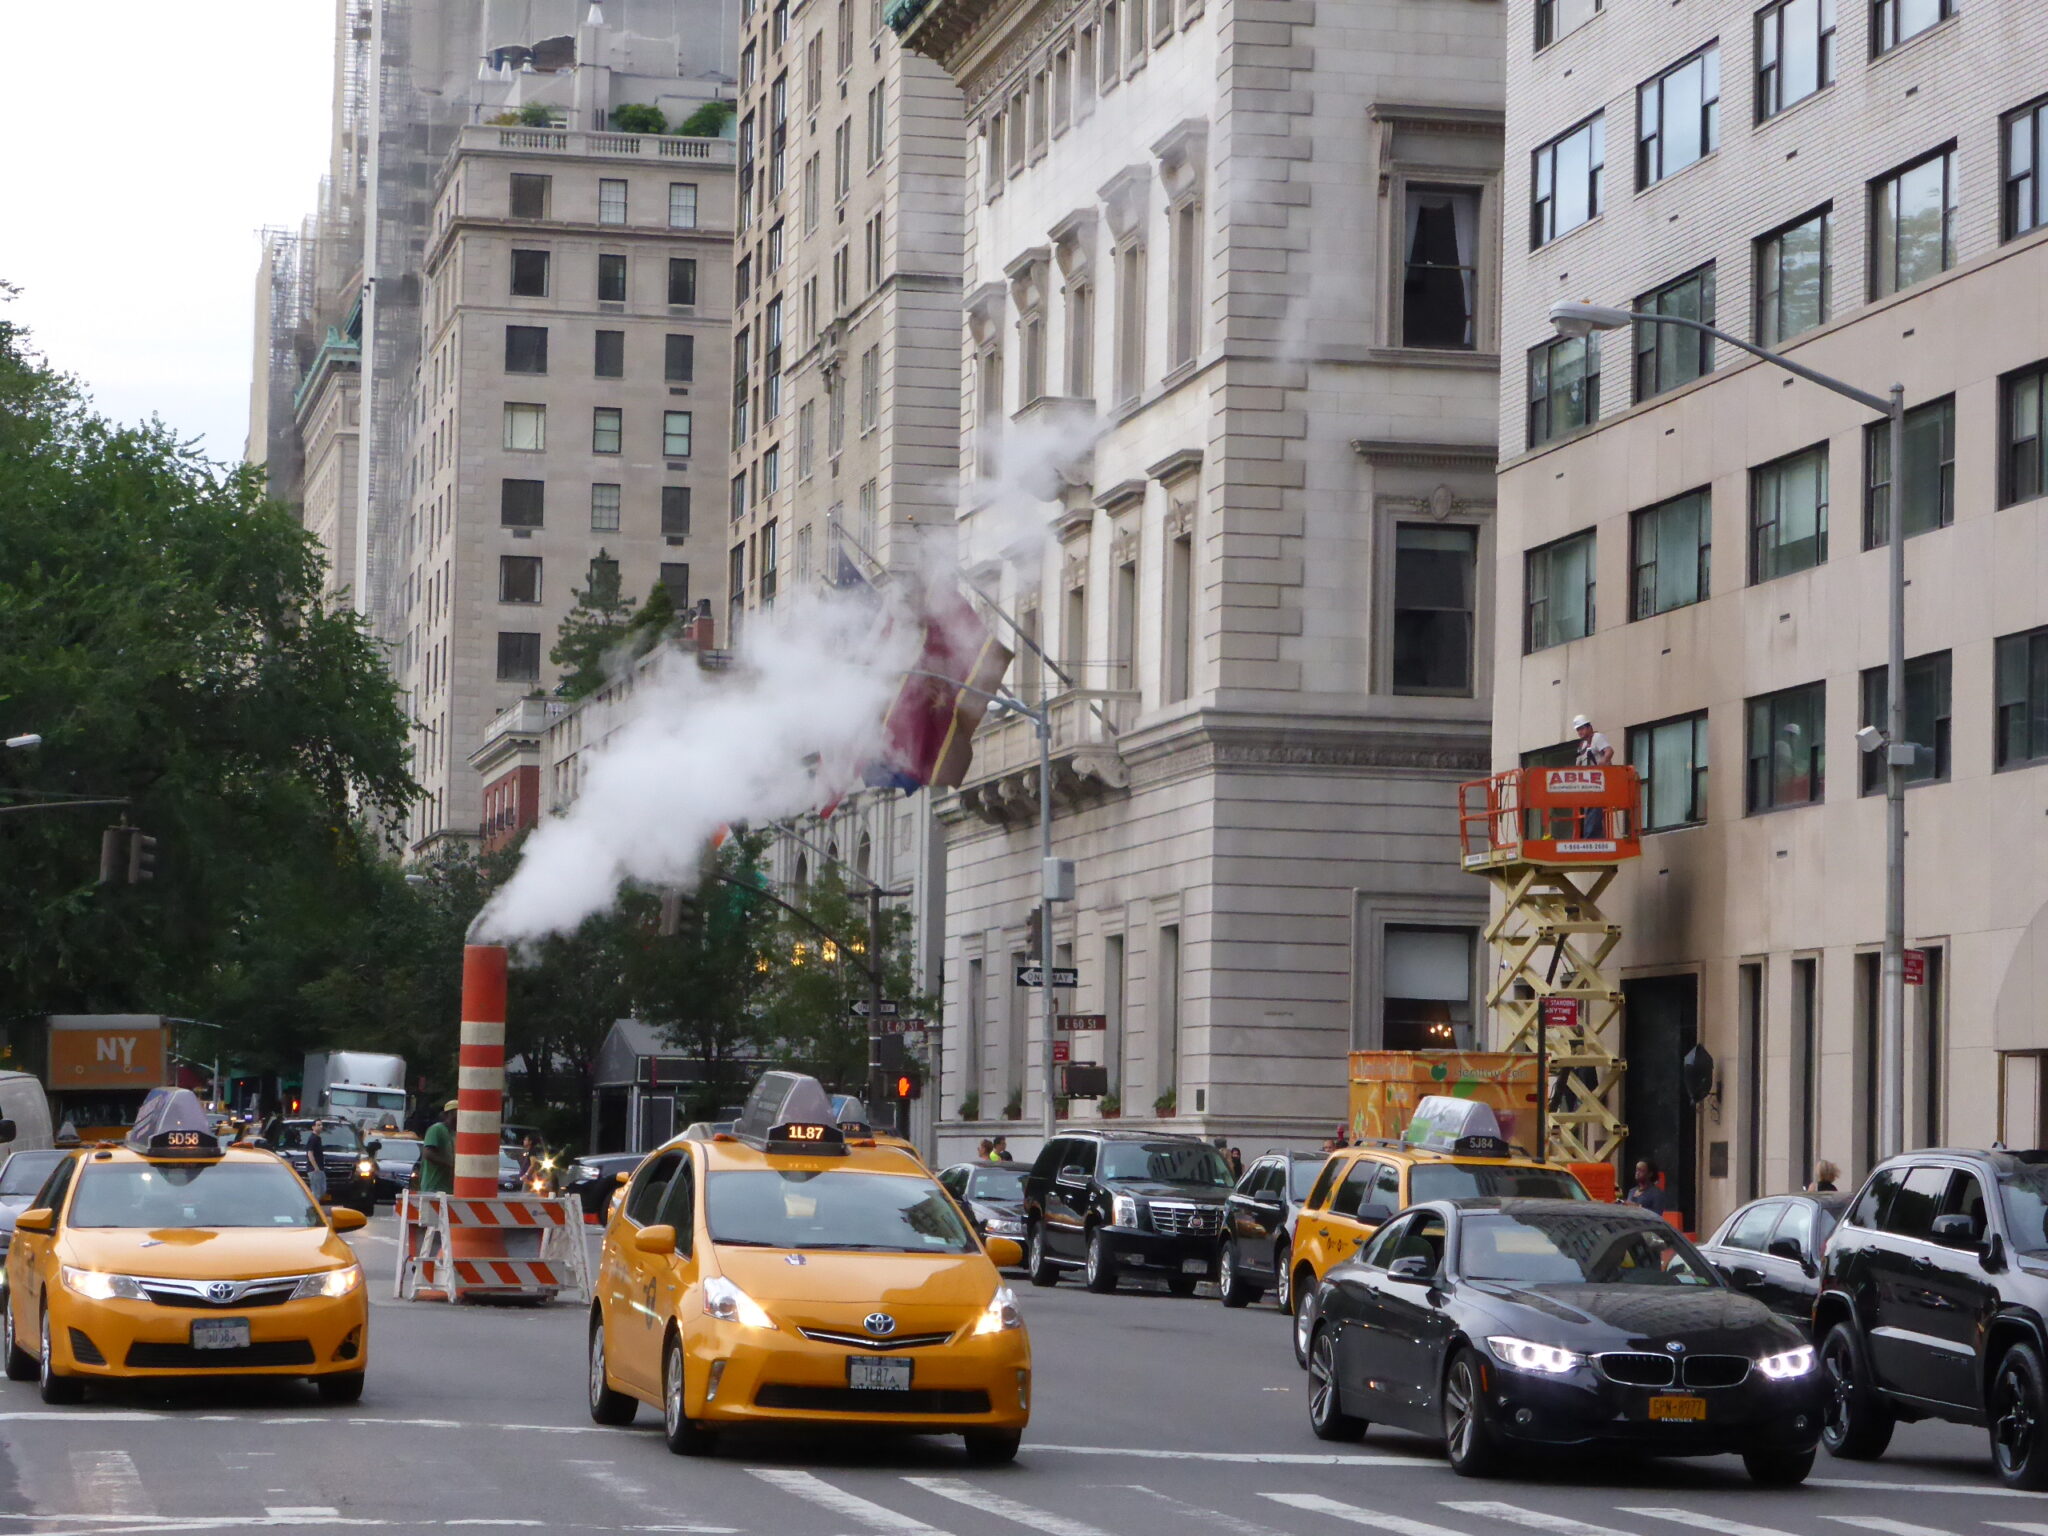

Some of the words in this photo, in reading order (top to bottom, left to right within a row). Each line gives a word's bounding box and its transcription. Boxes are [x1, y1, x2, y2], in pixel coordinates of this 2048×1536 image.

[1549, 772, 1602, 785] ABLE
[1064, 1019, 1069, 1029] E
[1073, 1019, 1084, 1029] 60
[96, 1037, 137, 1066] NY
[168, 1132, 199, 1145] 5D58
[788, 1125, 824, 1140] 1L87
[1469, 1137, 1494, 1149] 5J84
